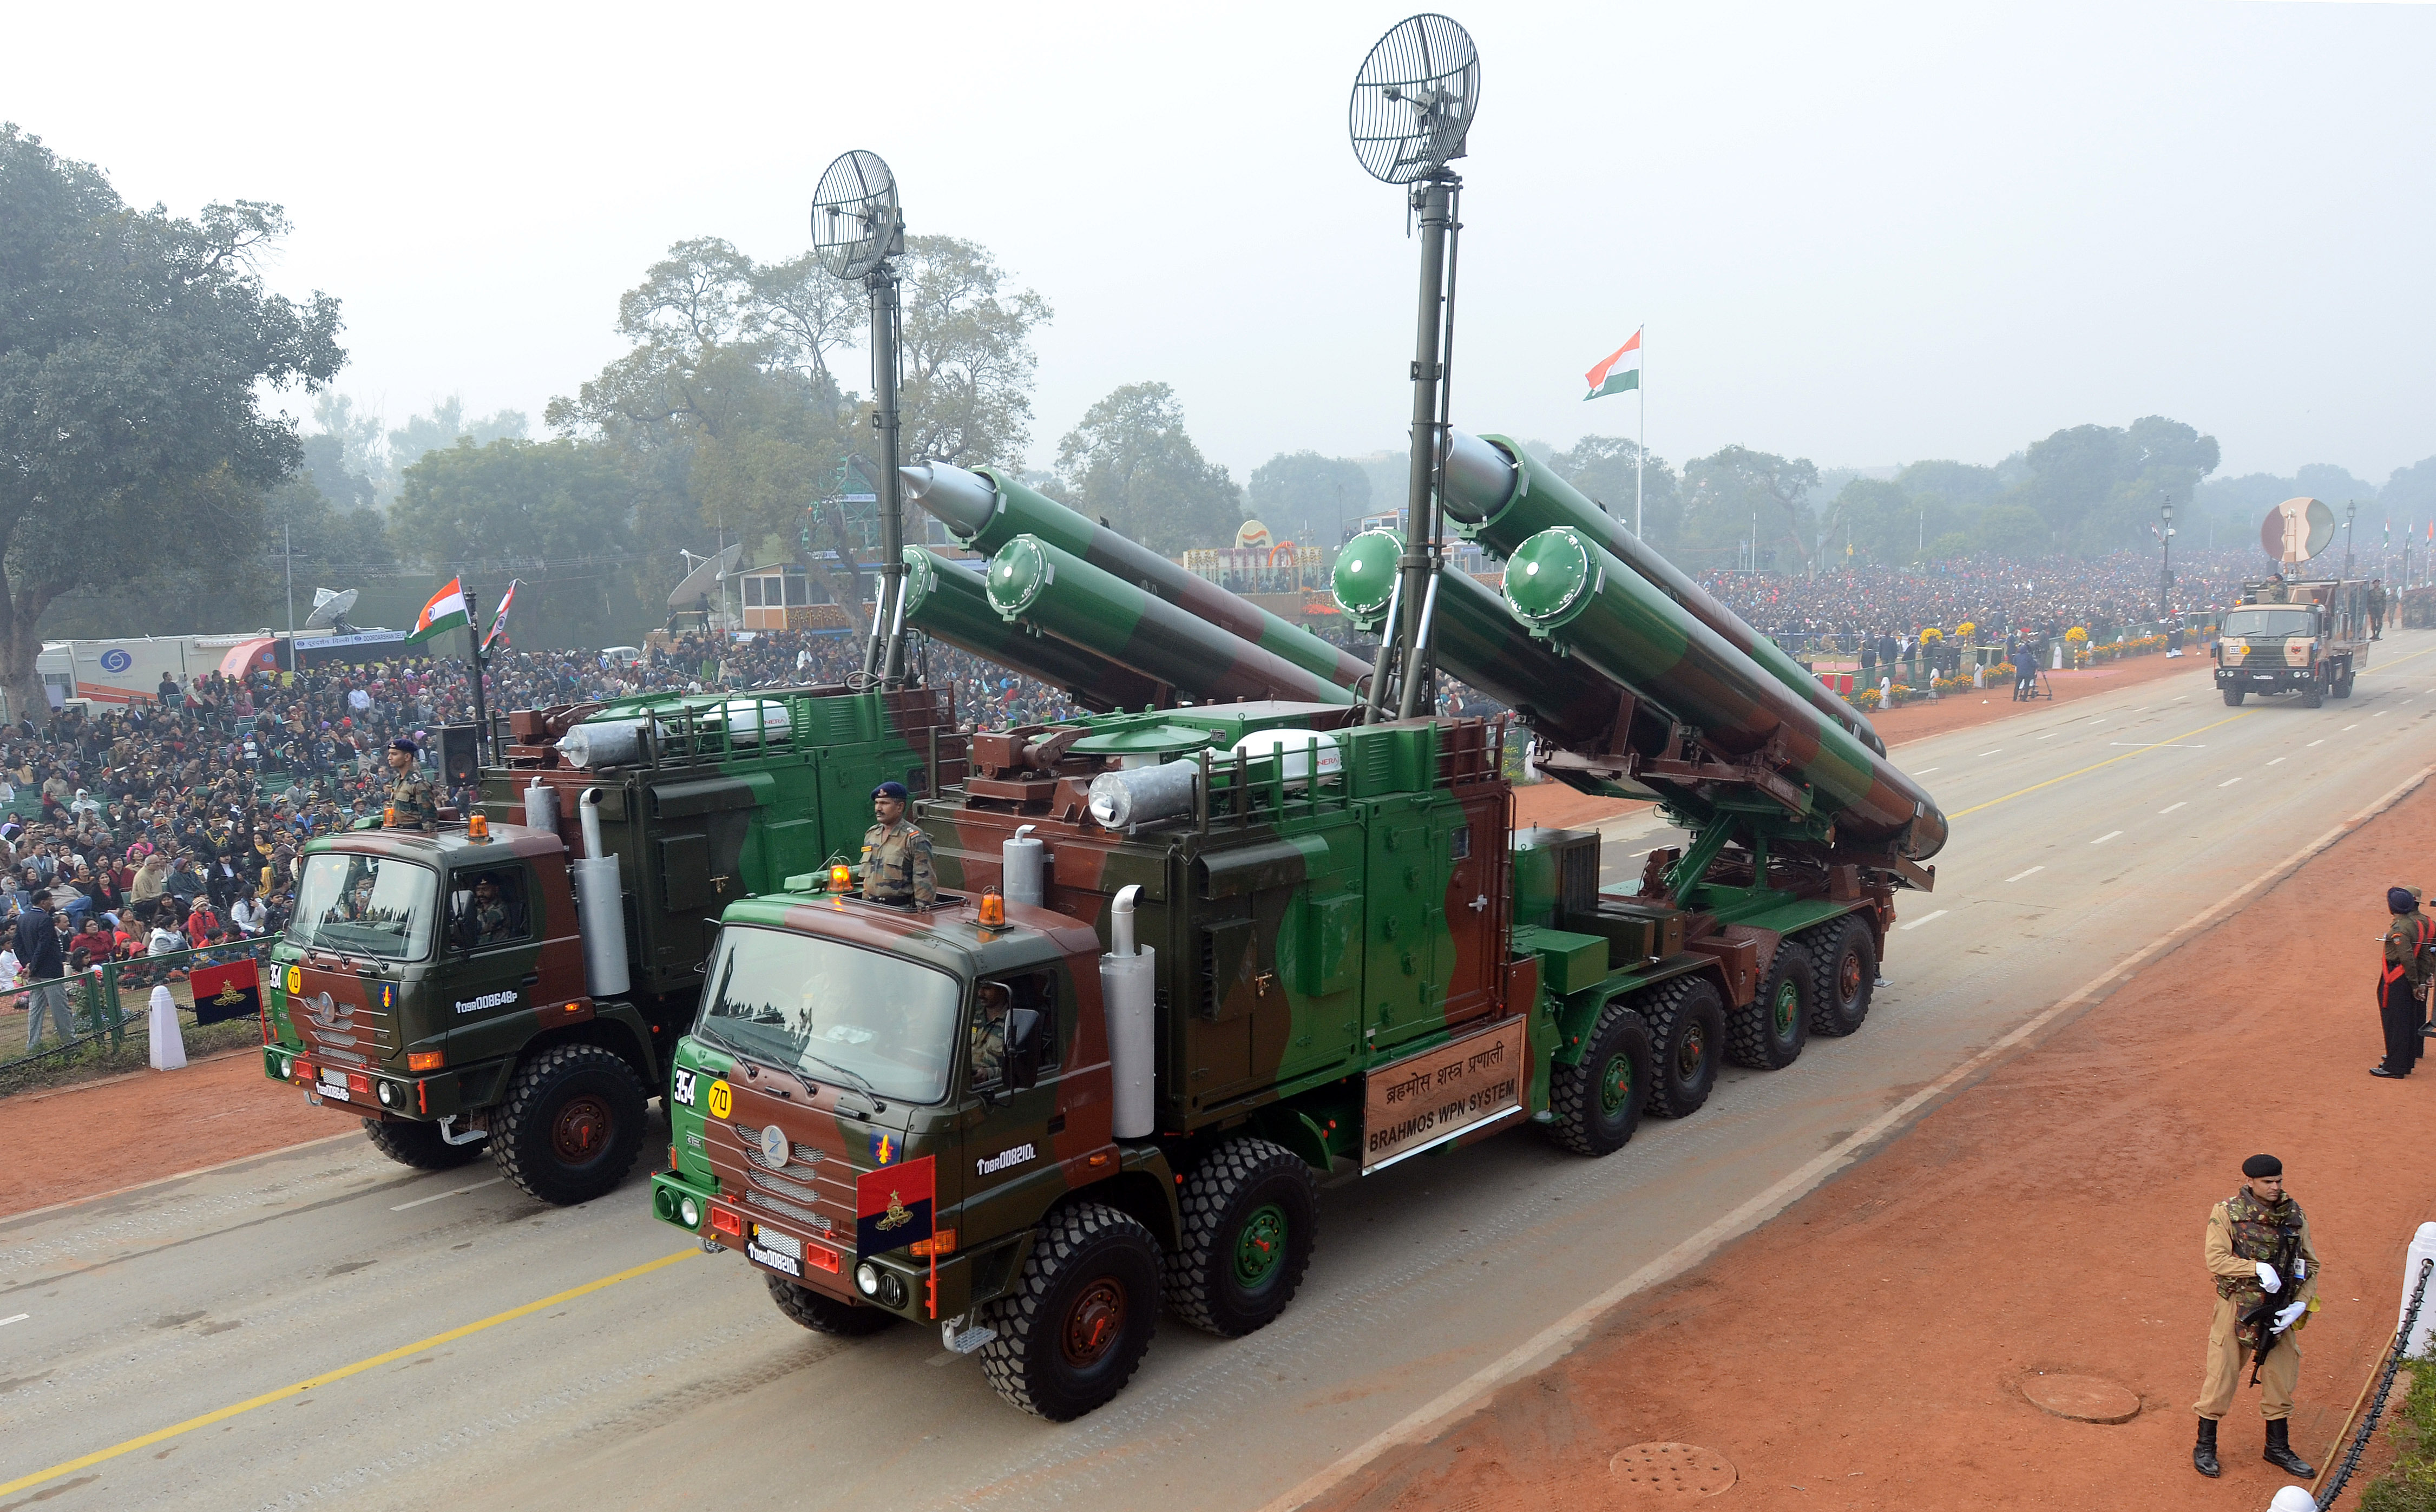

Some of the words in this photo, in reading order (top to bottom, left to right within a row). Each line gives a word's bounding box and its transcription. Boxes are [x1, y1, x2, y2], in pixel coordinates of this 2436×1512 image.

[1317, 758, 1338, 766] NERA
[270, 964, 282, 989] 354
[290, 971, 298, 989] 70
[1437, 1061, 1464, 1085] शस्त्र
[1468, 1041, 1505, 1074] प्रणाली
[674, 1069, 697, 1106] 354
[712, 1087, 728, 1112] 70
[1369, 1111, 1435, 1153] BRAHMOS
[1439, 1099, 1466, 1125] WPN
[1469, 1077, 1515, 1112] SYSTEM
